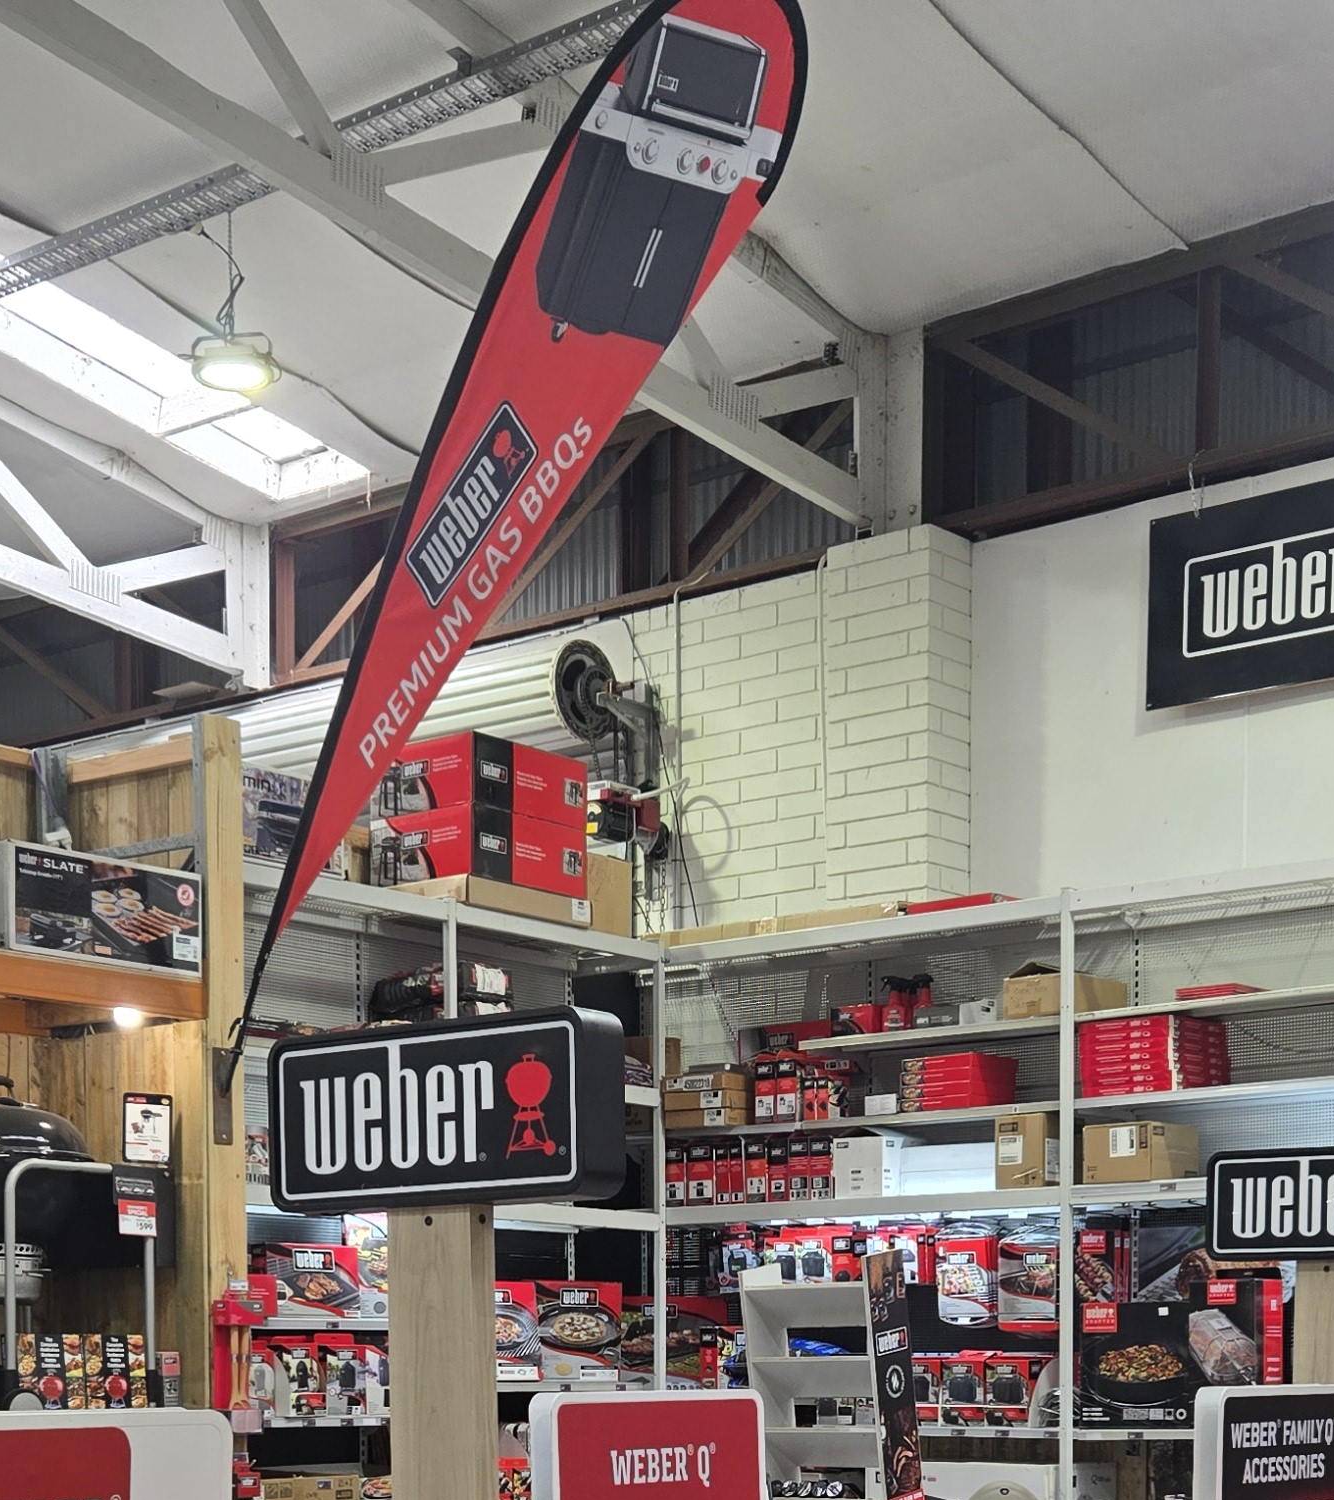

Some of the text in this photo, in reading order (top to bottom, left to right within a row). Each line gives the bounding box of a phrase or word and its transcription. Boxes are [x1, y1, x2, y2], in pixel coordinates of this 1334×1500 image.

[419, 455, 499, 586] weber
[358, 596, 473, 770] PREMIUM
[468, 521, 522, 602] GAS
[518, 416, 593, 526] BBQs
[43, 858, 85, 875] SLATE
[299, 1044, 495, 1175] weber
[296, 1251, 324, 1269] weber
[562, 1290, 590, 1305] weber
[1208, 1282, 1235, 1293] weber
[1086, 1307, 1115, 1320] weber
[1230, 1421, 1277, 1449] WEBER
[1282, 1419, 1323, 1446] FAMILY
[610, 1444, 711, 1488] WEBER Q
[1242, 1453, 1325, 1485] ACCESSORIES
